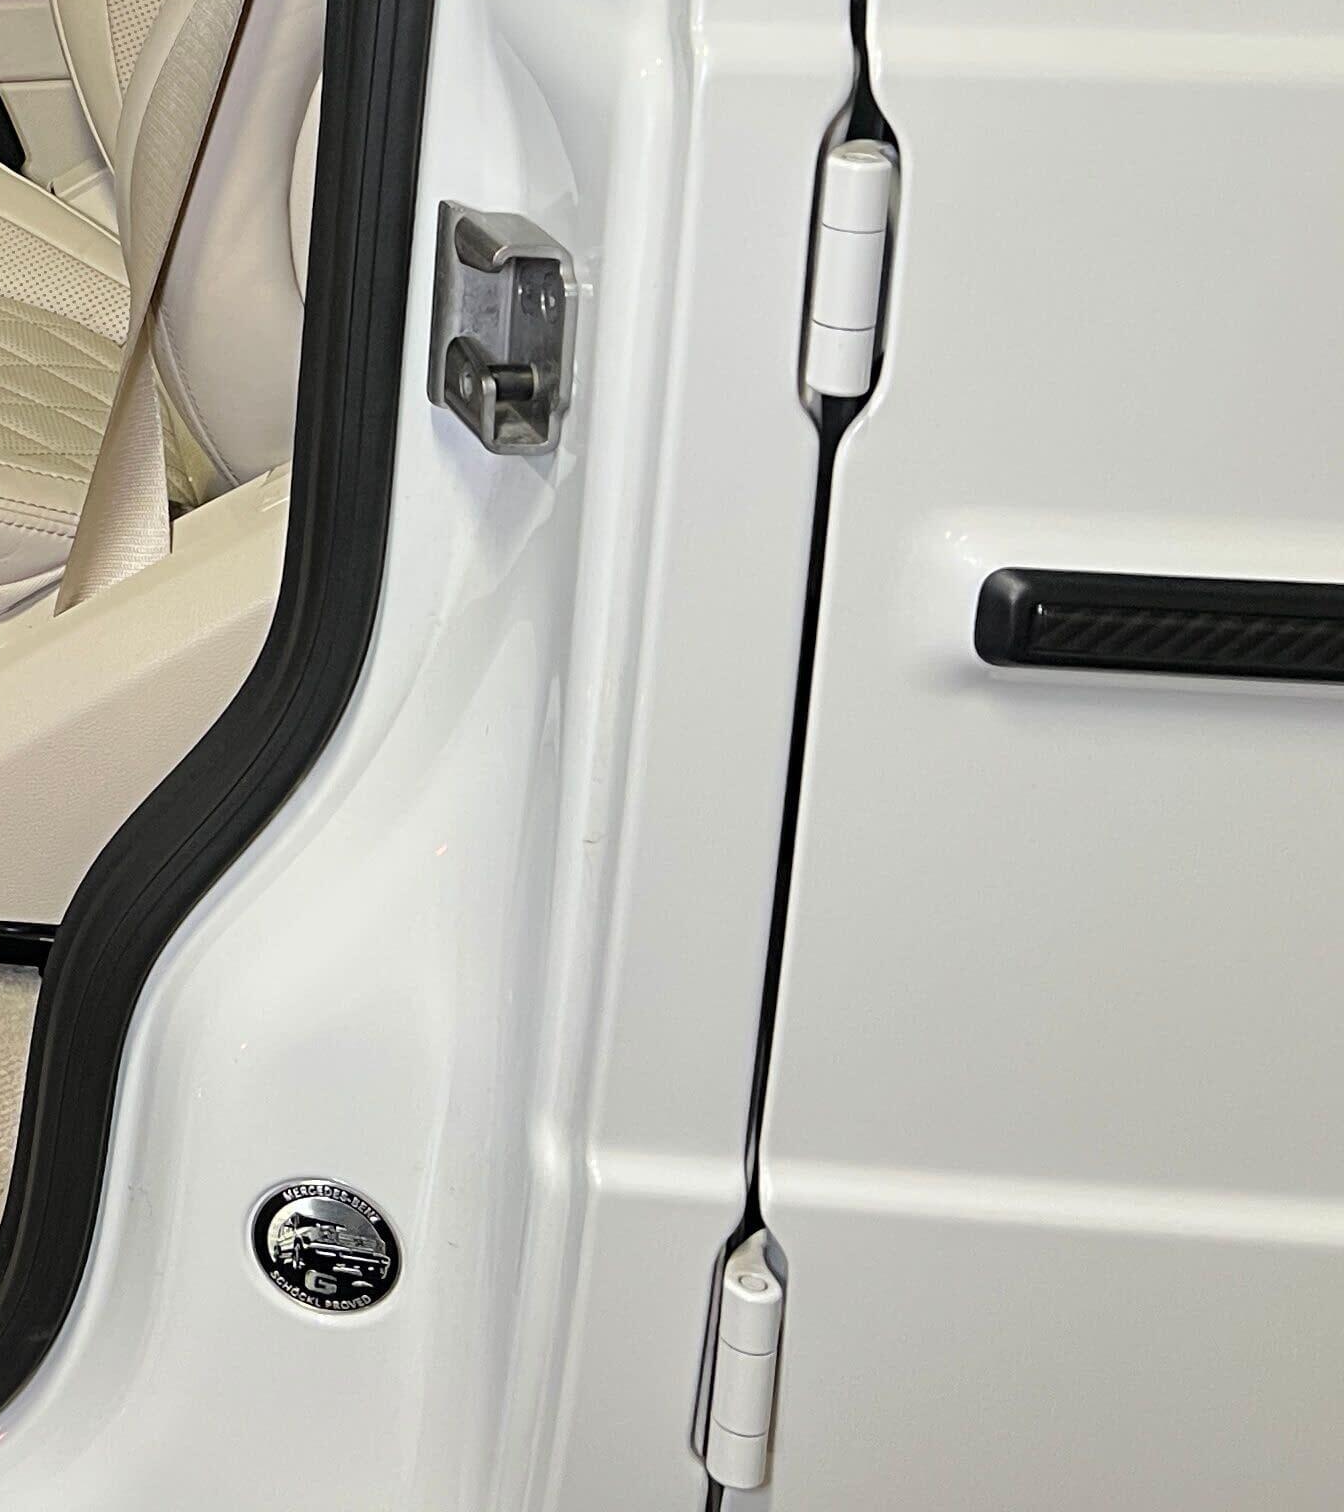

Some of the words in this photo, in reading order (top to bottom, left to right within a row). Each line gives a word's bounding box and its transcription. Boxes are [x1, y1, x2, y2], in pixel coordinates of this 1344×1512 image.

[282, 1185, 380, 1224] MERCEDES-BENZ
[305, 1270, 338, 1294] G
[325, 1294, 372, 1310] PROVED
